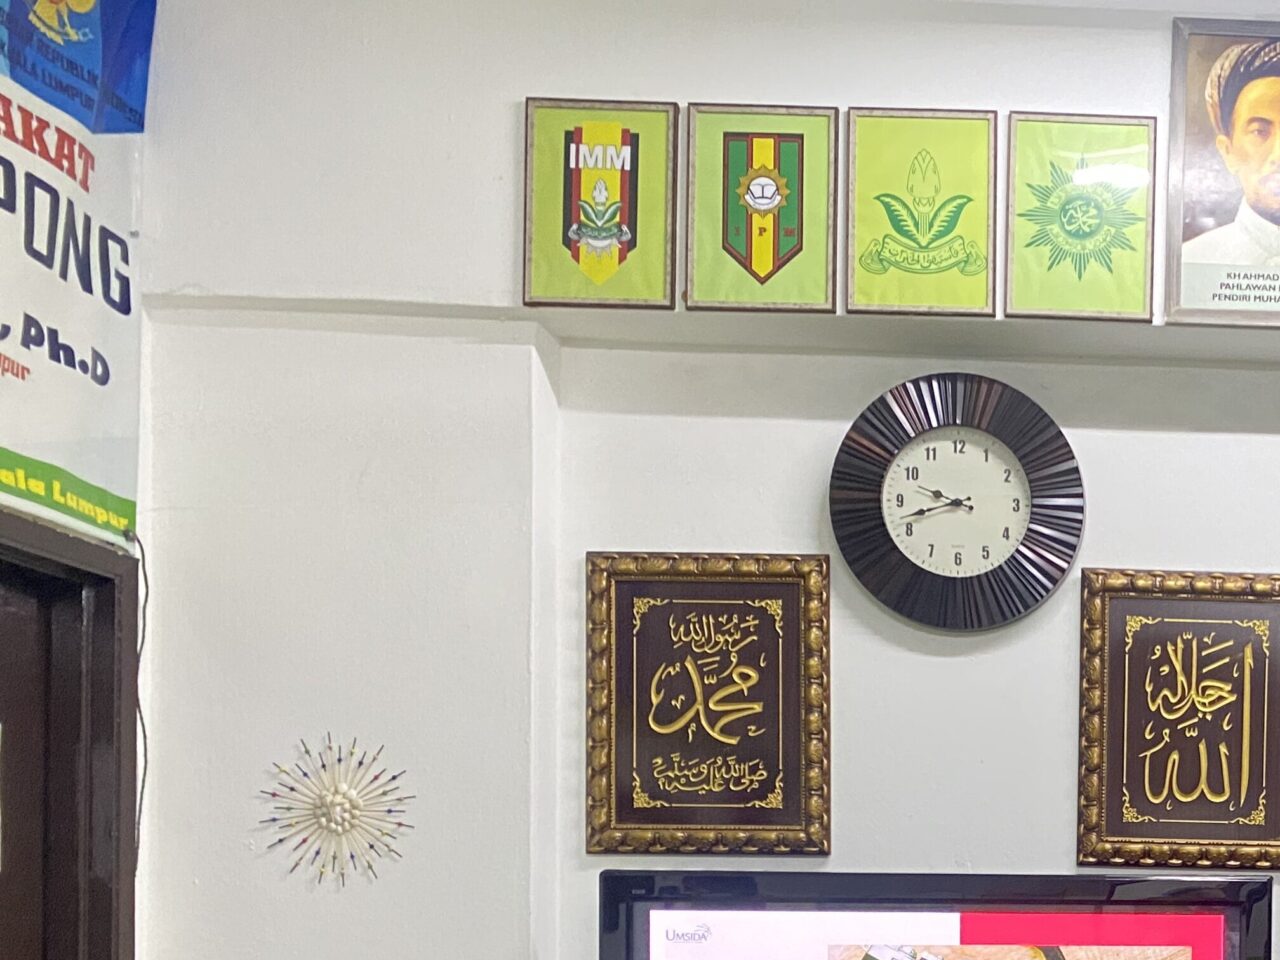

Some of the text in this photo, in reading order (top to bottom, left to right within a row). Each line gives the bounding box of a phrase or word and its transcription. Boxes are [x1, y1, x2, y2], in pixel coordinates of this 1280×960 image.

[569, 143, 631, 171] IMM
[758, 226, 767, 237] P
[1226, 272, 1241, 281] KH
[1242, 273, 1280, 282] AHMAD
[1219, 282, 1276, 292] PAHLAWAN
[1212, 293, 1252, 302] PENDIRI
[20, 312, 110, 386] Ph.D
[925, 447, 937, 461] 11
[952, 440, 966, 454] 12
[983, 449, 989, 462] 1
[905, 467, 919, 481] 10
[1004, 469, 1012, 483] 2
[52, 480, 129, 530] Lumpur
[896, 494, 904, 508] 9
[1013, 498, 1020, 512] 3
[905, 522, 913, 536] 8
[1002, 527, 1010, 541] 4
[928, 544, 935, 558] 7
[982, 546, 990, 560] 5
[954, 552, 962, 566] 6
